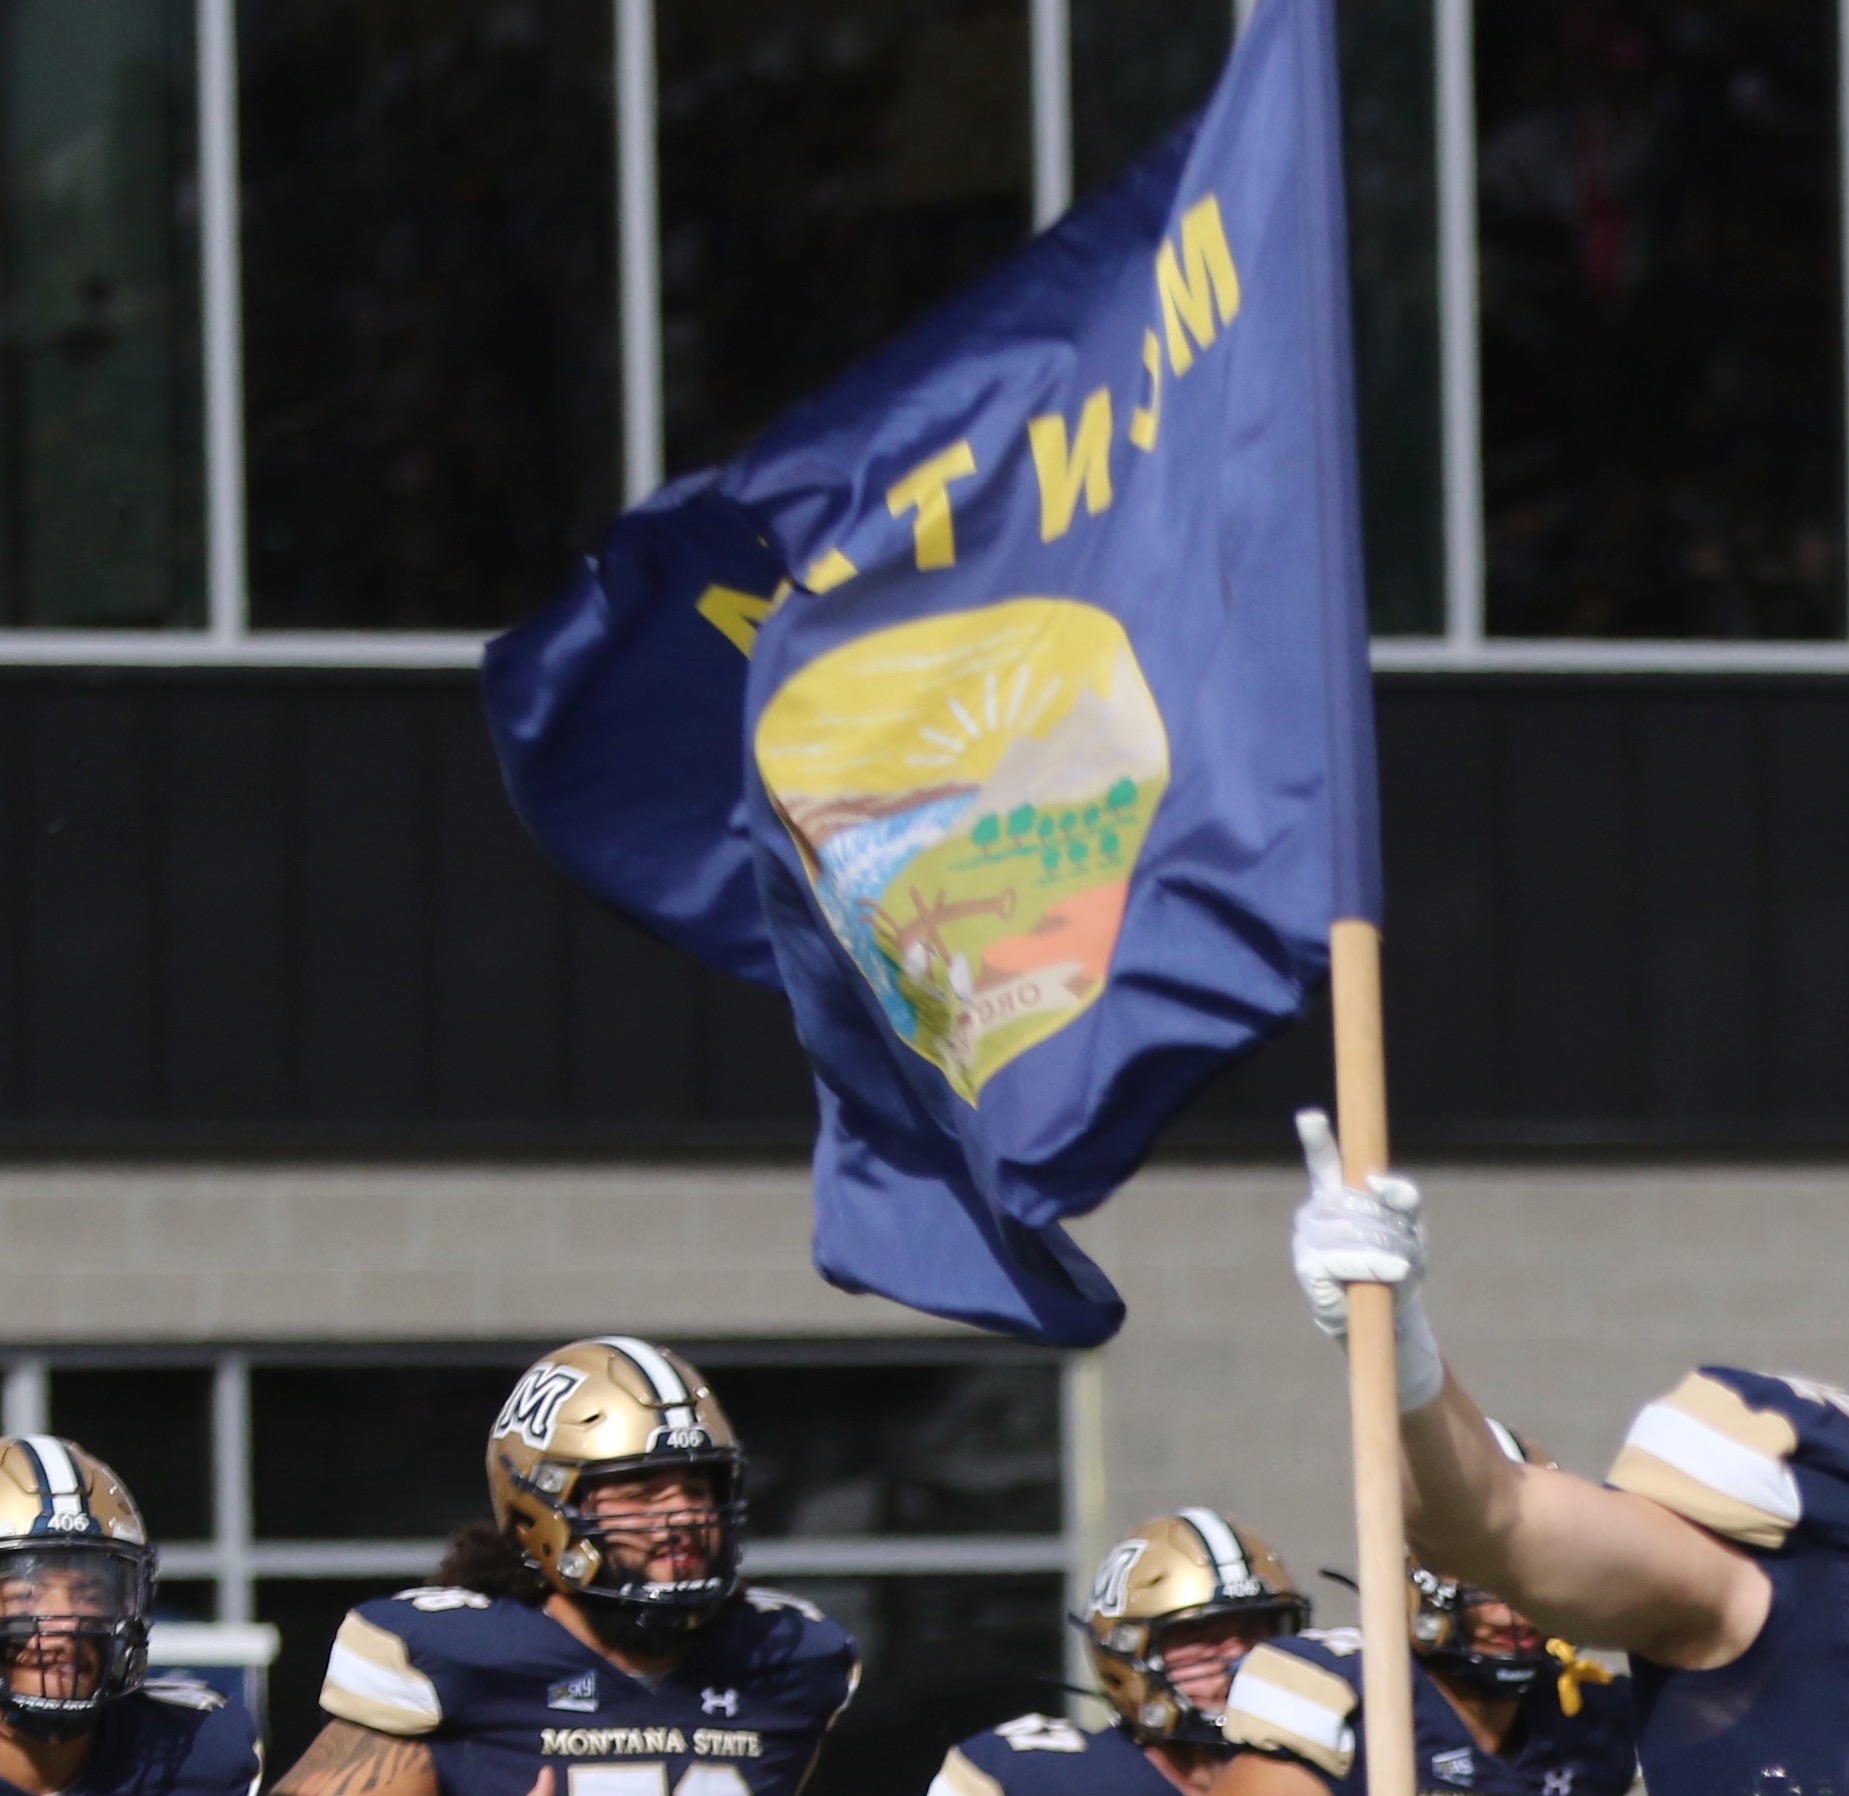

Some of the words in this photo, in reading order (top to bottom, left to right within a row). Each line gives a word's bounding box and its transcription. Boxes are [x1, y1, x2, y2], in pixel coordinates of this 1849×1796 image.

[492, 1361, 592, 1452] M
[666, 1429, 702, 1449] 406
[46, 1512, 91, 1532] 406
[539, 1726, 689, 1757] MONTANA
[692, 1727, 764, 1758] STATE
